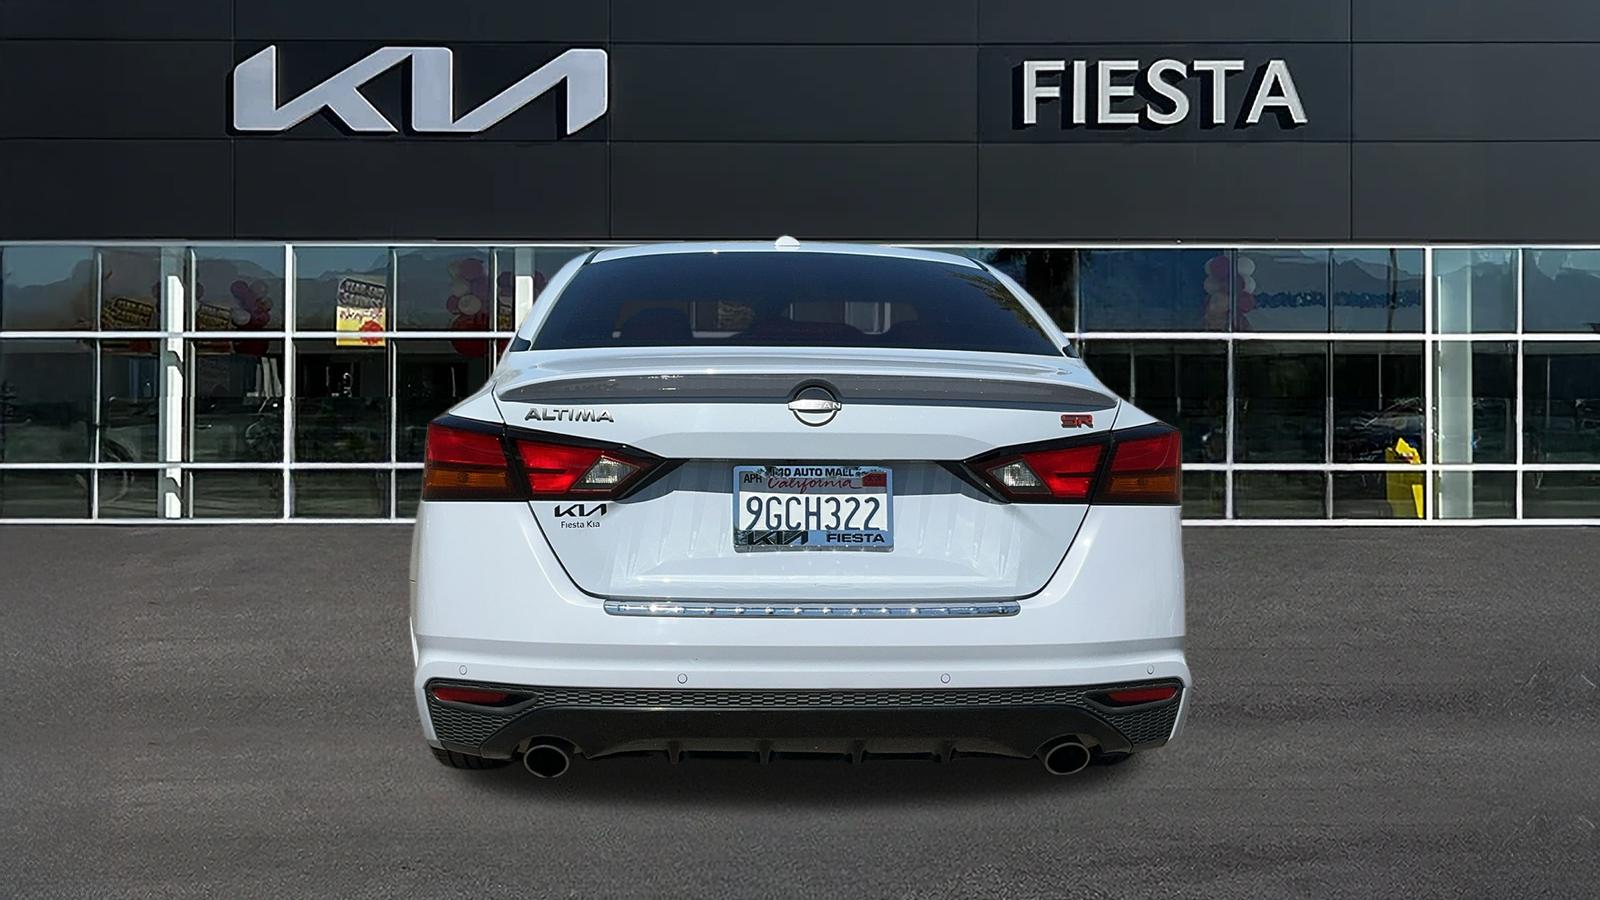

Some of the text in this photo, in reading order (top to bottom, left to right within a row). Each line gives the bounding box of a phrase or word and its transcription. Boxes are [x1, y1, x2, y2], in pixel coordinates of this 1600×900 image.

[233, 45, 608, 135] KIA
[1023, 59, 1308, 125] FIESTA
[524, 407, 615, 423] ALTIMA
[1061, 414, 1094, 428] SR
[744, 473, 763, 484] APR
[794, 468, 823, 477] AUTO
[825, 468, 855, 477] MALL
[768, 477, 862, 494] California
[554, 503, 608, 518] KIA
[746, 495, 881, 531] 9GCH322
[560, 520, 601, 529] Fiesta Kia
[826, 533, 885, 543] FIESTA
